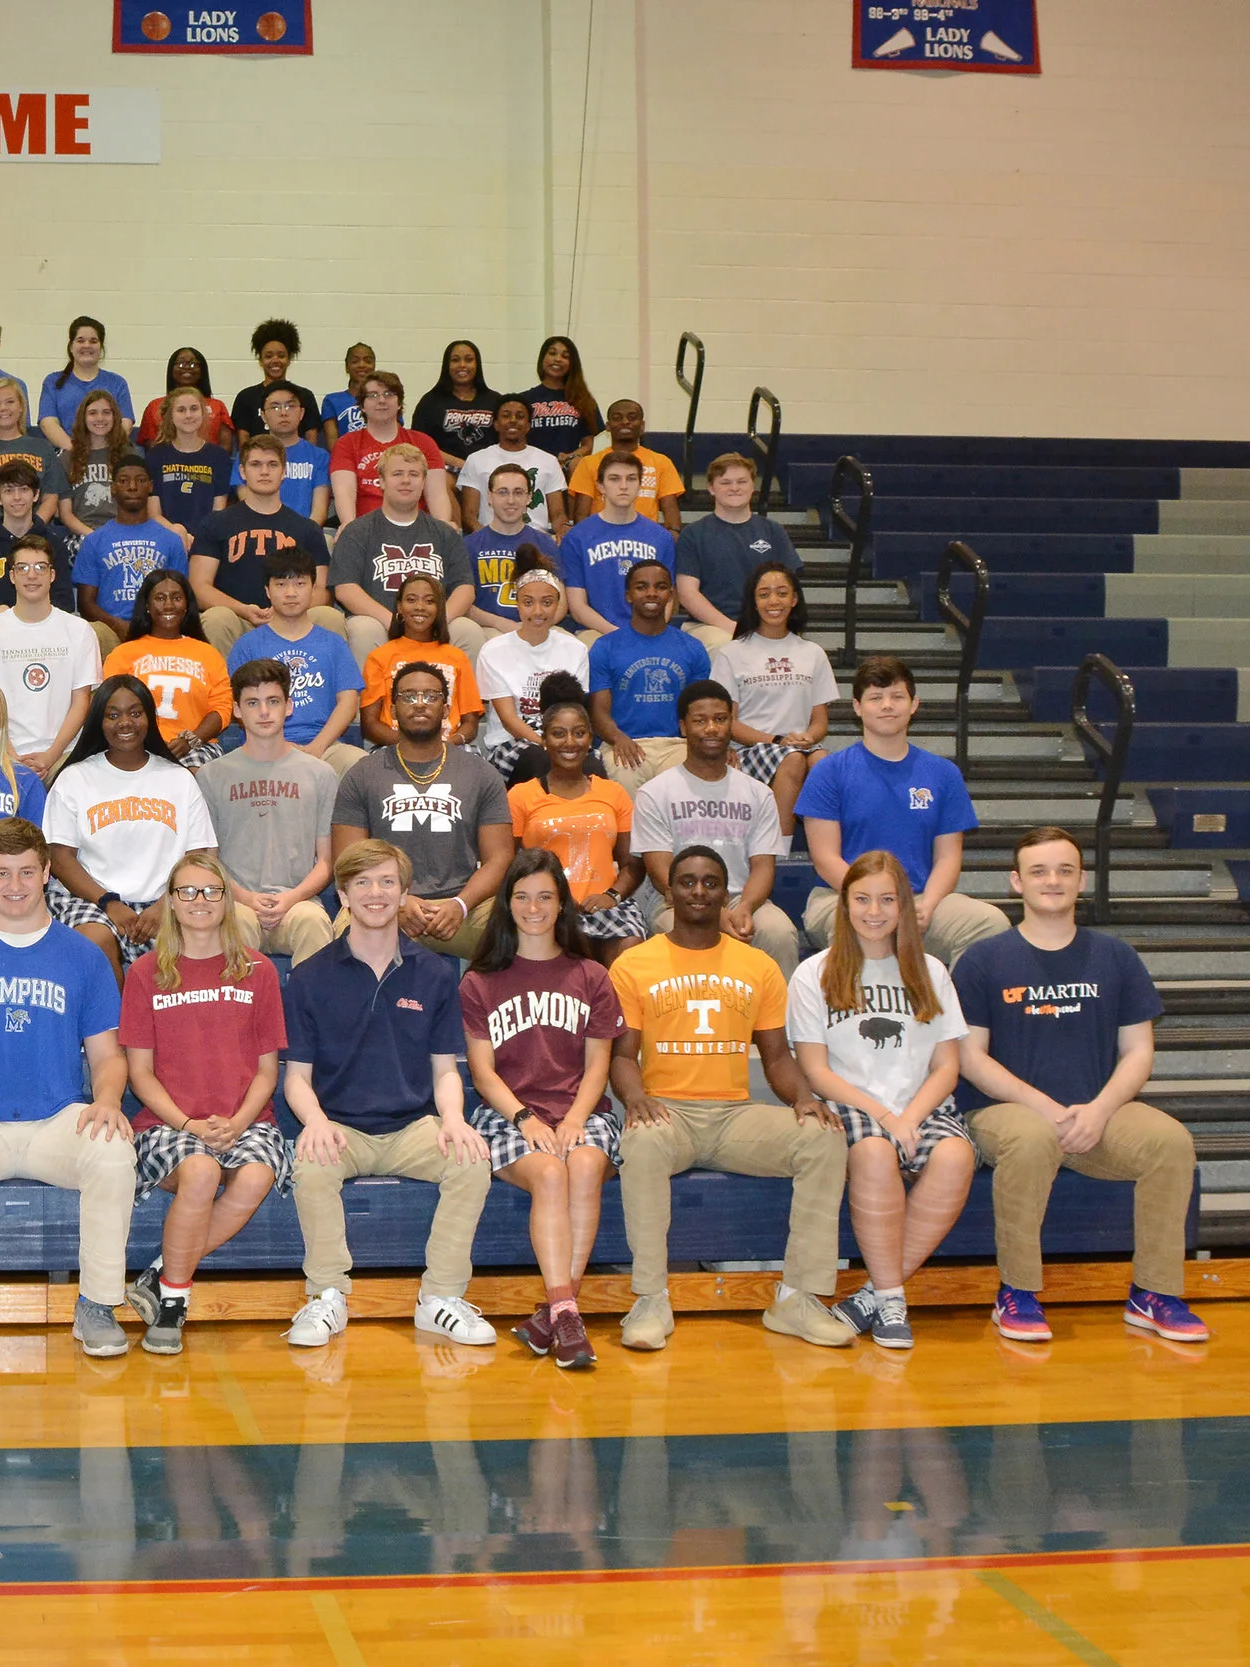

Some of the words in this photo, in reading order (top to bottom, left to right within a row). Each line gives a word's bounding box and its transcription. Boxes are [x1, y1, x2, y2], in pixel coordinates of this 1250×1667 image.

[188, 11, 238, 27] LADY
[186, 26, 240, 44] LIONS
[925, 27, 971, 42] LADY
[925, 43, 974, 60] LIONS
[444, 410, 493, 428] PANTHERS
[162, 464, 213, 476] CHATTANOOGA
[228, 529, 297, 563] UTM
[479, 550, 517, 558] CHATTA
[587, 540, 657, 566] MEMPHIS
[102, 546, 168, 570] MEMPHIS
[387, 558, 432, 572] STATE
[478, 558, 516, 584] MO
[113, 588, 139, 602] TIG
[308, 655, 318, 664] OF
[625, 656, 660, 679] UNIVERSITY
[661, 657, 671, 666] OF
[743, 673, 793, 685] MISSISSIPPI
[147, 674, 191, 719] T
[634, 692, 674, 703] TIGERS
[229, 779, 300, 802] ALABAMA
[395, 796, 449, 814] STATE
[671, 800, 753, 821] LIPSCOMB
[152, 988, 220, 1011] CRIMSON
[649, 973, 753, 1019] TENNESSEE
[1027, 983, 1098, 1001] MARTIN
[487, 991, 591, 1050] BELMONT
[686, 1000, 721, 1034] T
